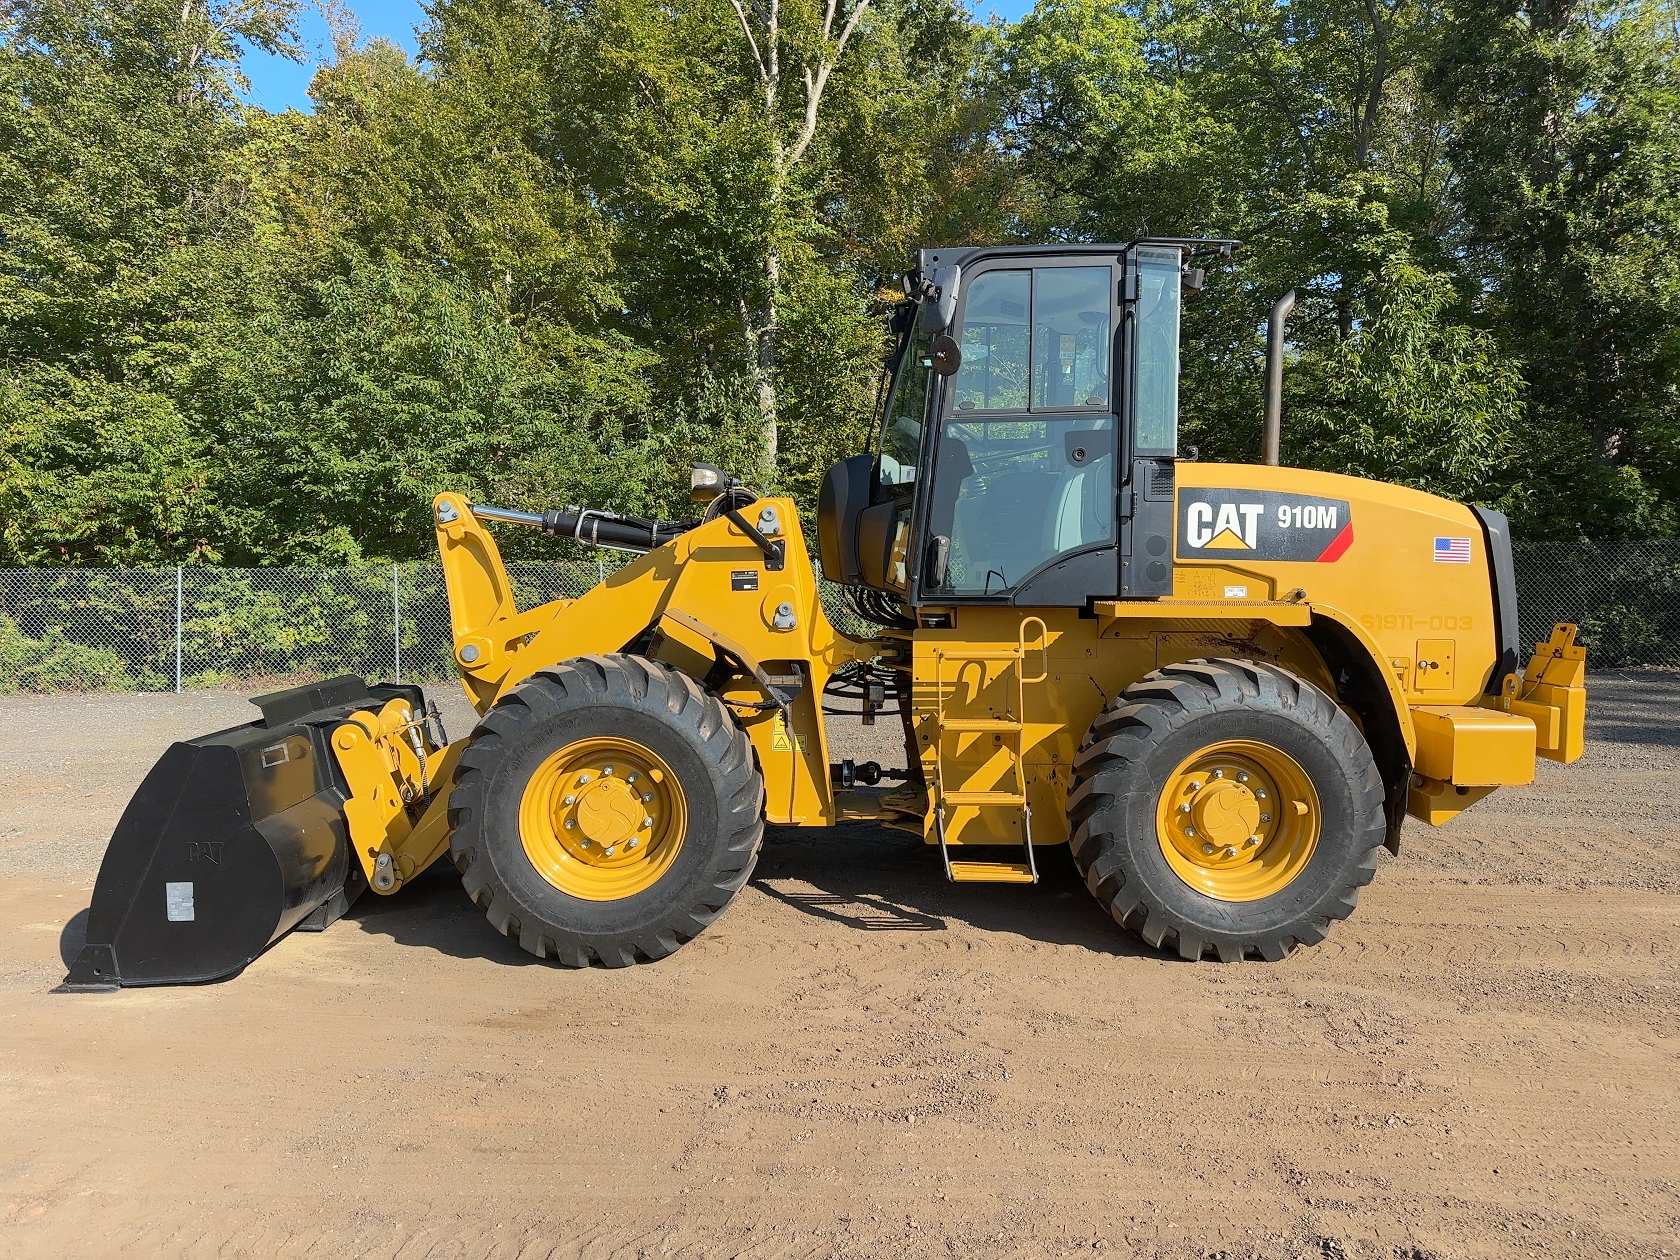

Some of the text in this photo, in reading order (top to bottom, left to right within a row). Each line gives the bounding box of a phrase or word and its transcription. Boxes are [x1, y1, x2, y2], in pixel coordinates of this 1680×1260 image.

[1187, 502, 1337, 549] CAT 910M
[1360, 614, 1473, 631] S1911-003
[186, 841, 225, 865] CAT
